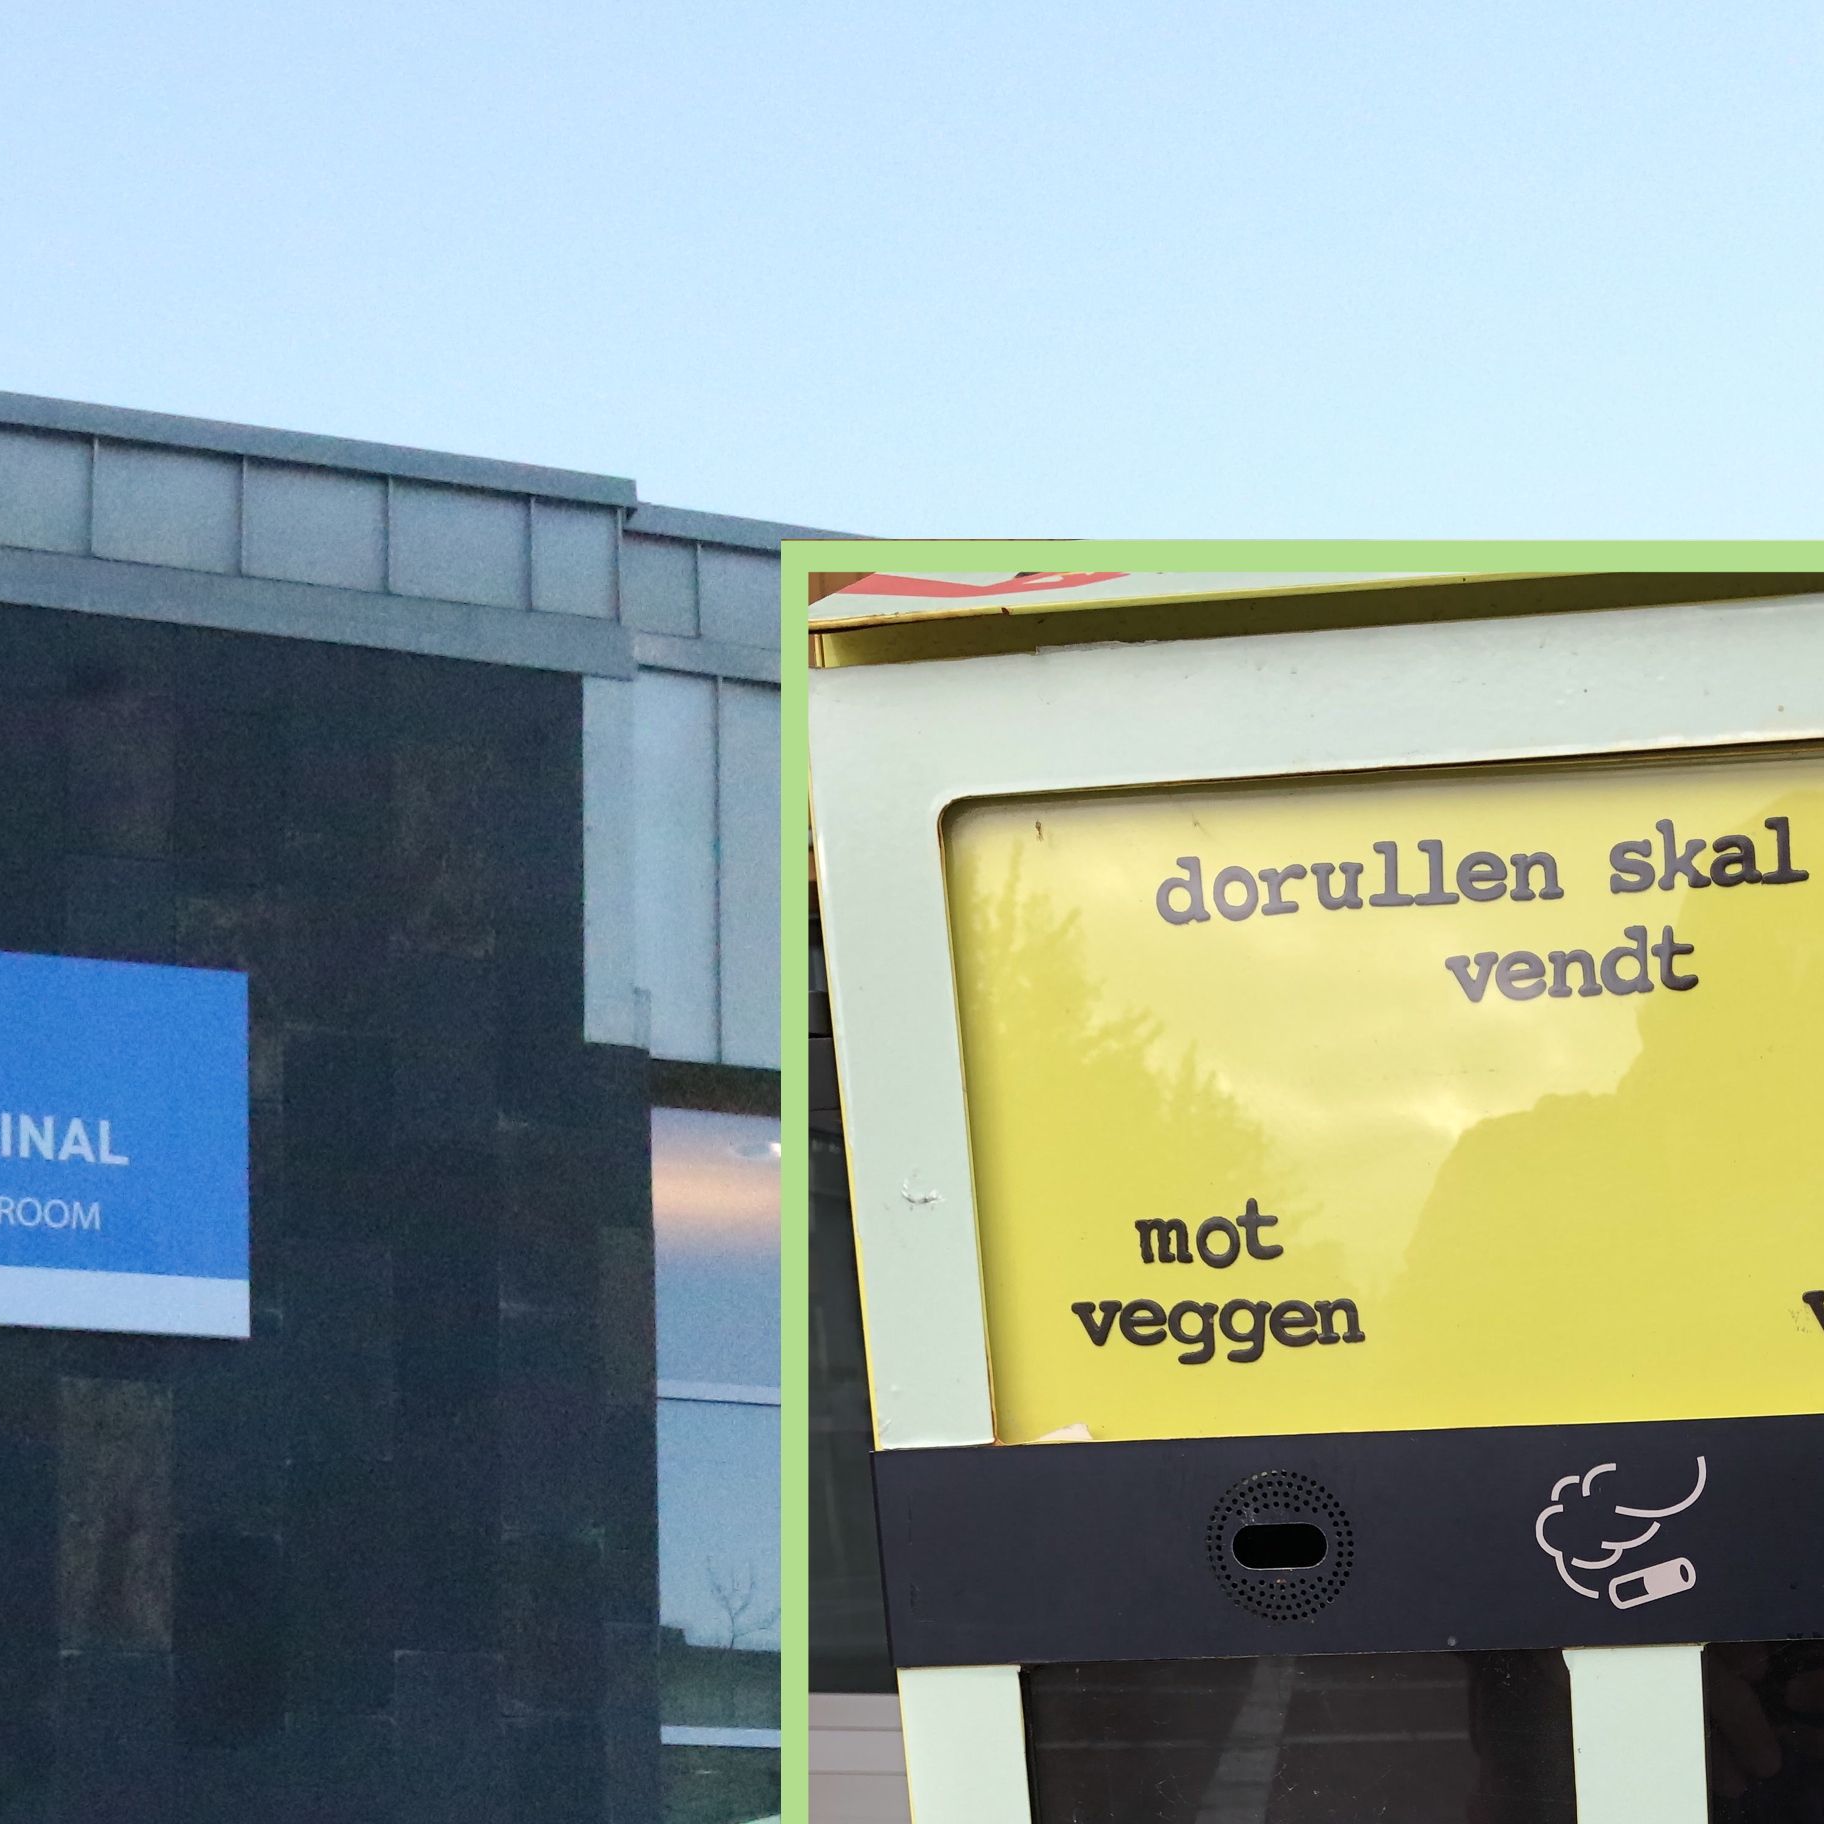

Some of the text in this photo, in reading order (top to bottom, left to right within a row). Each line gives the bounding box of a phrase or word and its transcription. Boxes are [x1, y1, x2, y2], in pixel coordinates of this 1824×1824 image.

[1156, 838, 1564, 926] dorullen
[1608, 816, 1811, 897] skal
[1445, 925, 1700, 1004] vendt
[1134, 1199, 1284, 1269] mot
[1070, 1297, 1366, 1365] veggen
